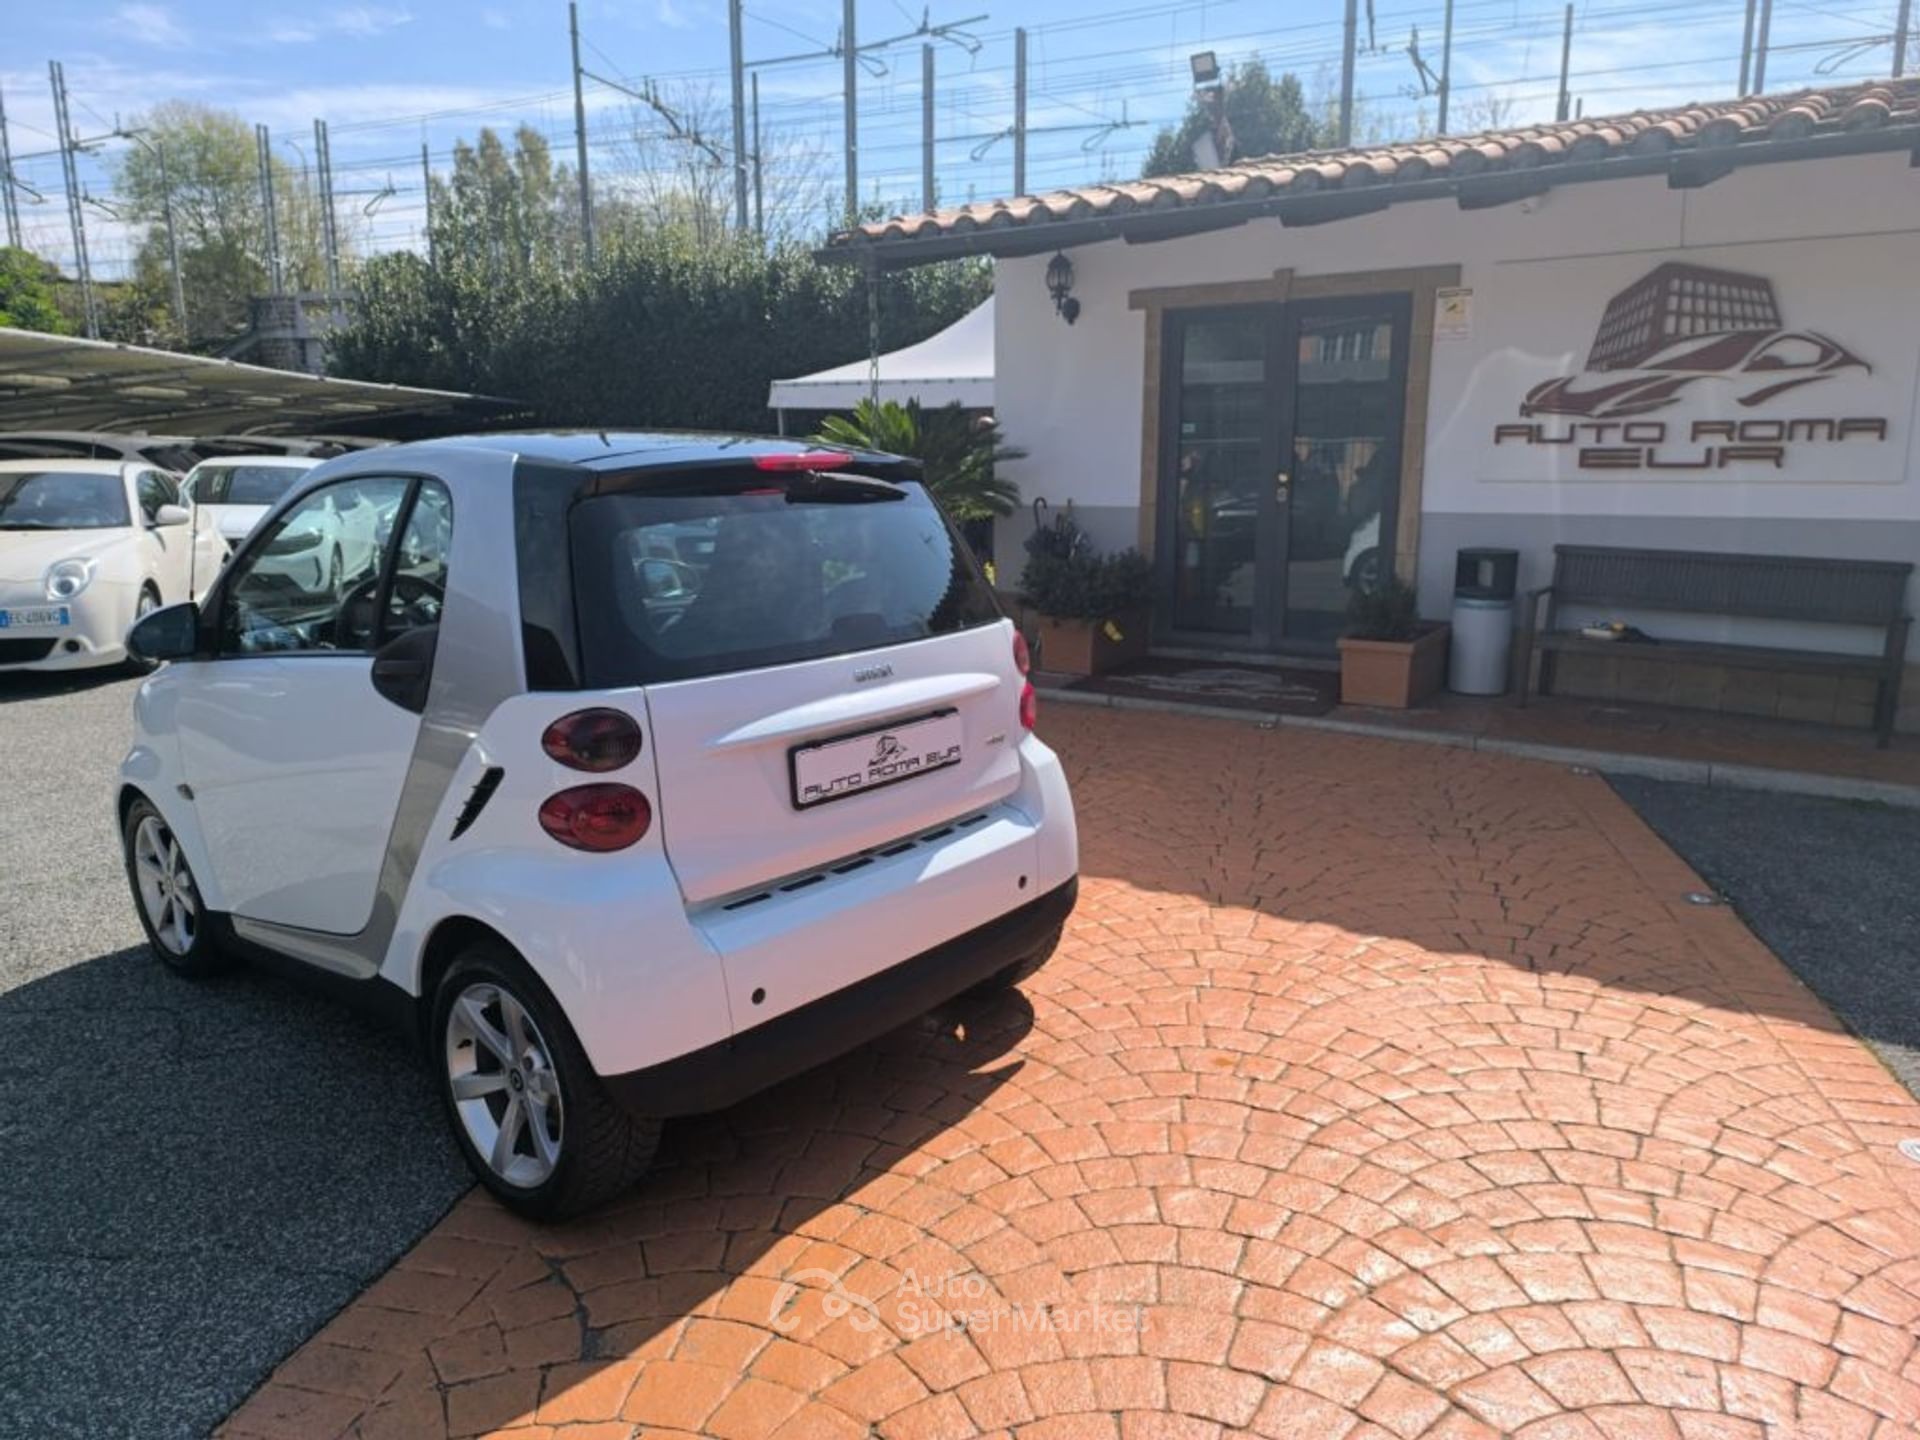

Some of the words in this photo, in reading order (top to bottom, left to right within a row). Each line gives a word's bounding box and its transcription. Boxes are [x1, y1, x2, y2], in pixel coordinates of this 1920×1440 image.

[1494, 421, 1666, 445] AUTO
[1690, 417, 1888, 443] ROMA
[1578, 446, 1784, 469] EUR
[804, 772, 861, 797] AUTO
[868, 757, 920, 780] ROMA
